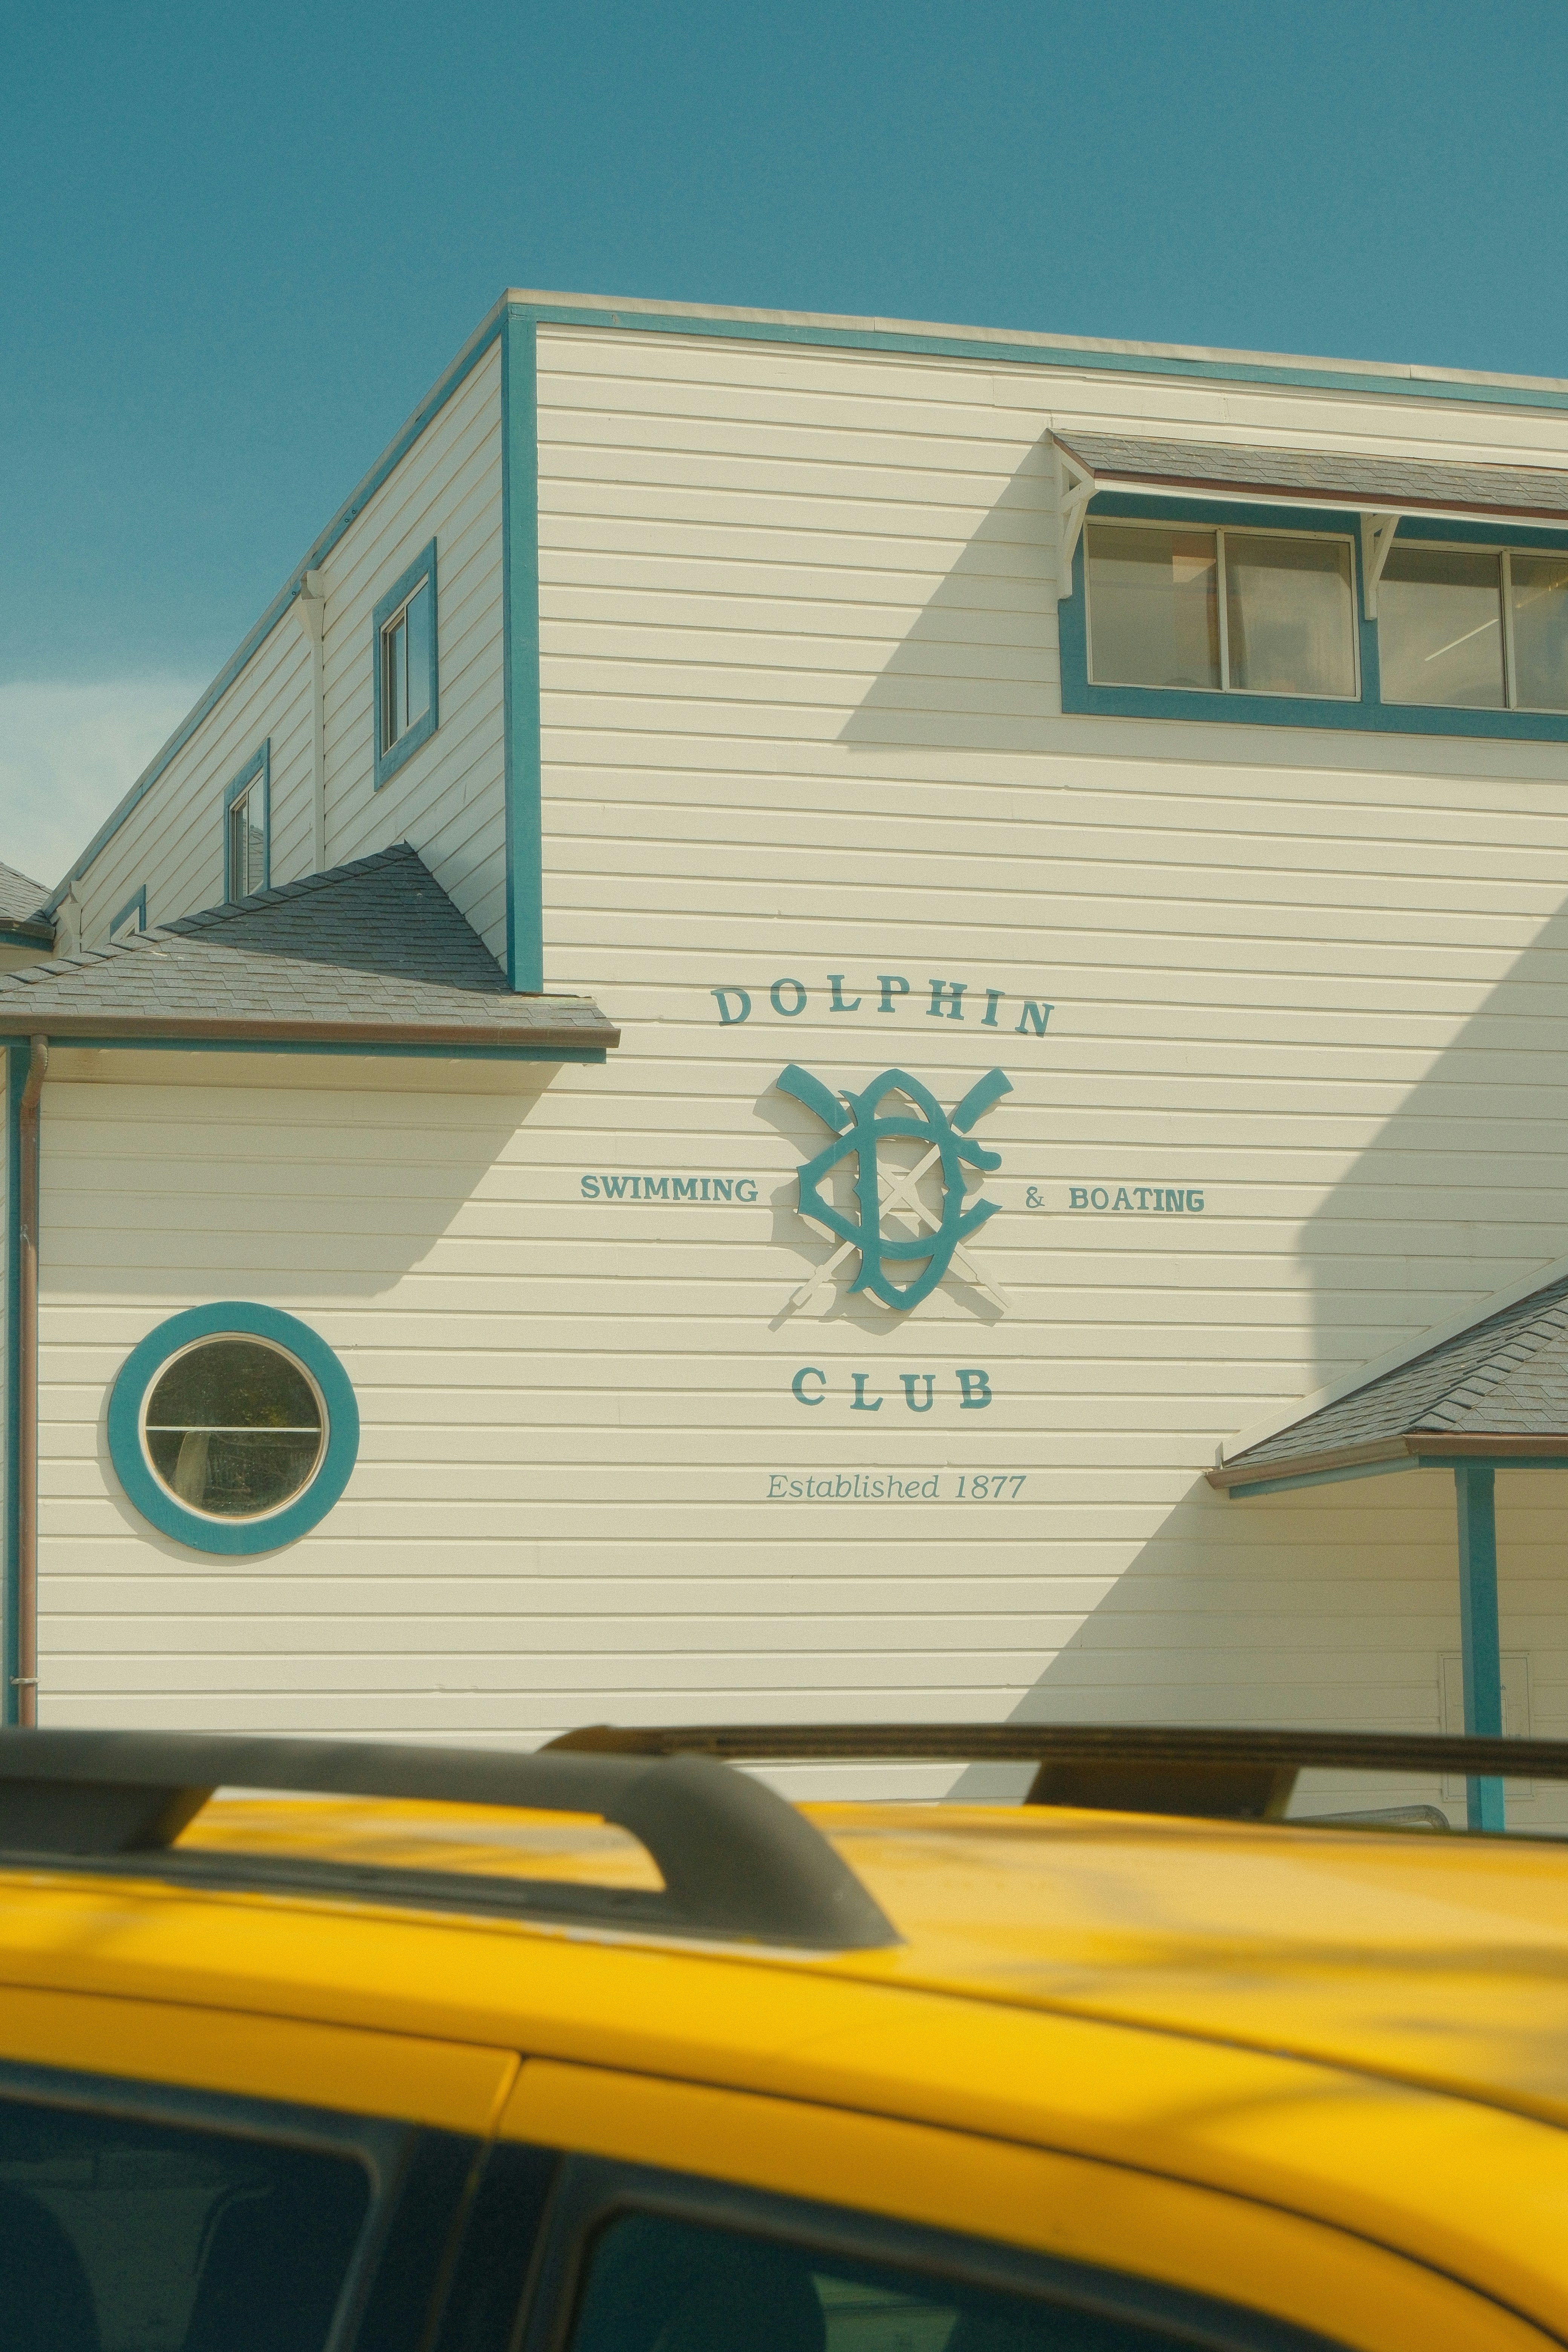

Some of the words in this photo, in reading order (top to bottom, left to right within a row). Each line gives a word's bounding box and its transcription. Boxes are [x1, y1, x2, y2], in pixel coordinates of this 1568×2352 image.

[711, 974, 1055, 1038] DOLPHIN
[580, 1174, 758, 1202] SWIMMING
[1025, 1185, 1046, 1209] &
[1069, 1186, 1205, 1213] BOATING
[791, 1366, 993, 1413] CLUB
[767, 1473, 939, 1499] Established
[955, 1475, 1027, 1499] 1877
